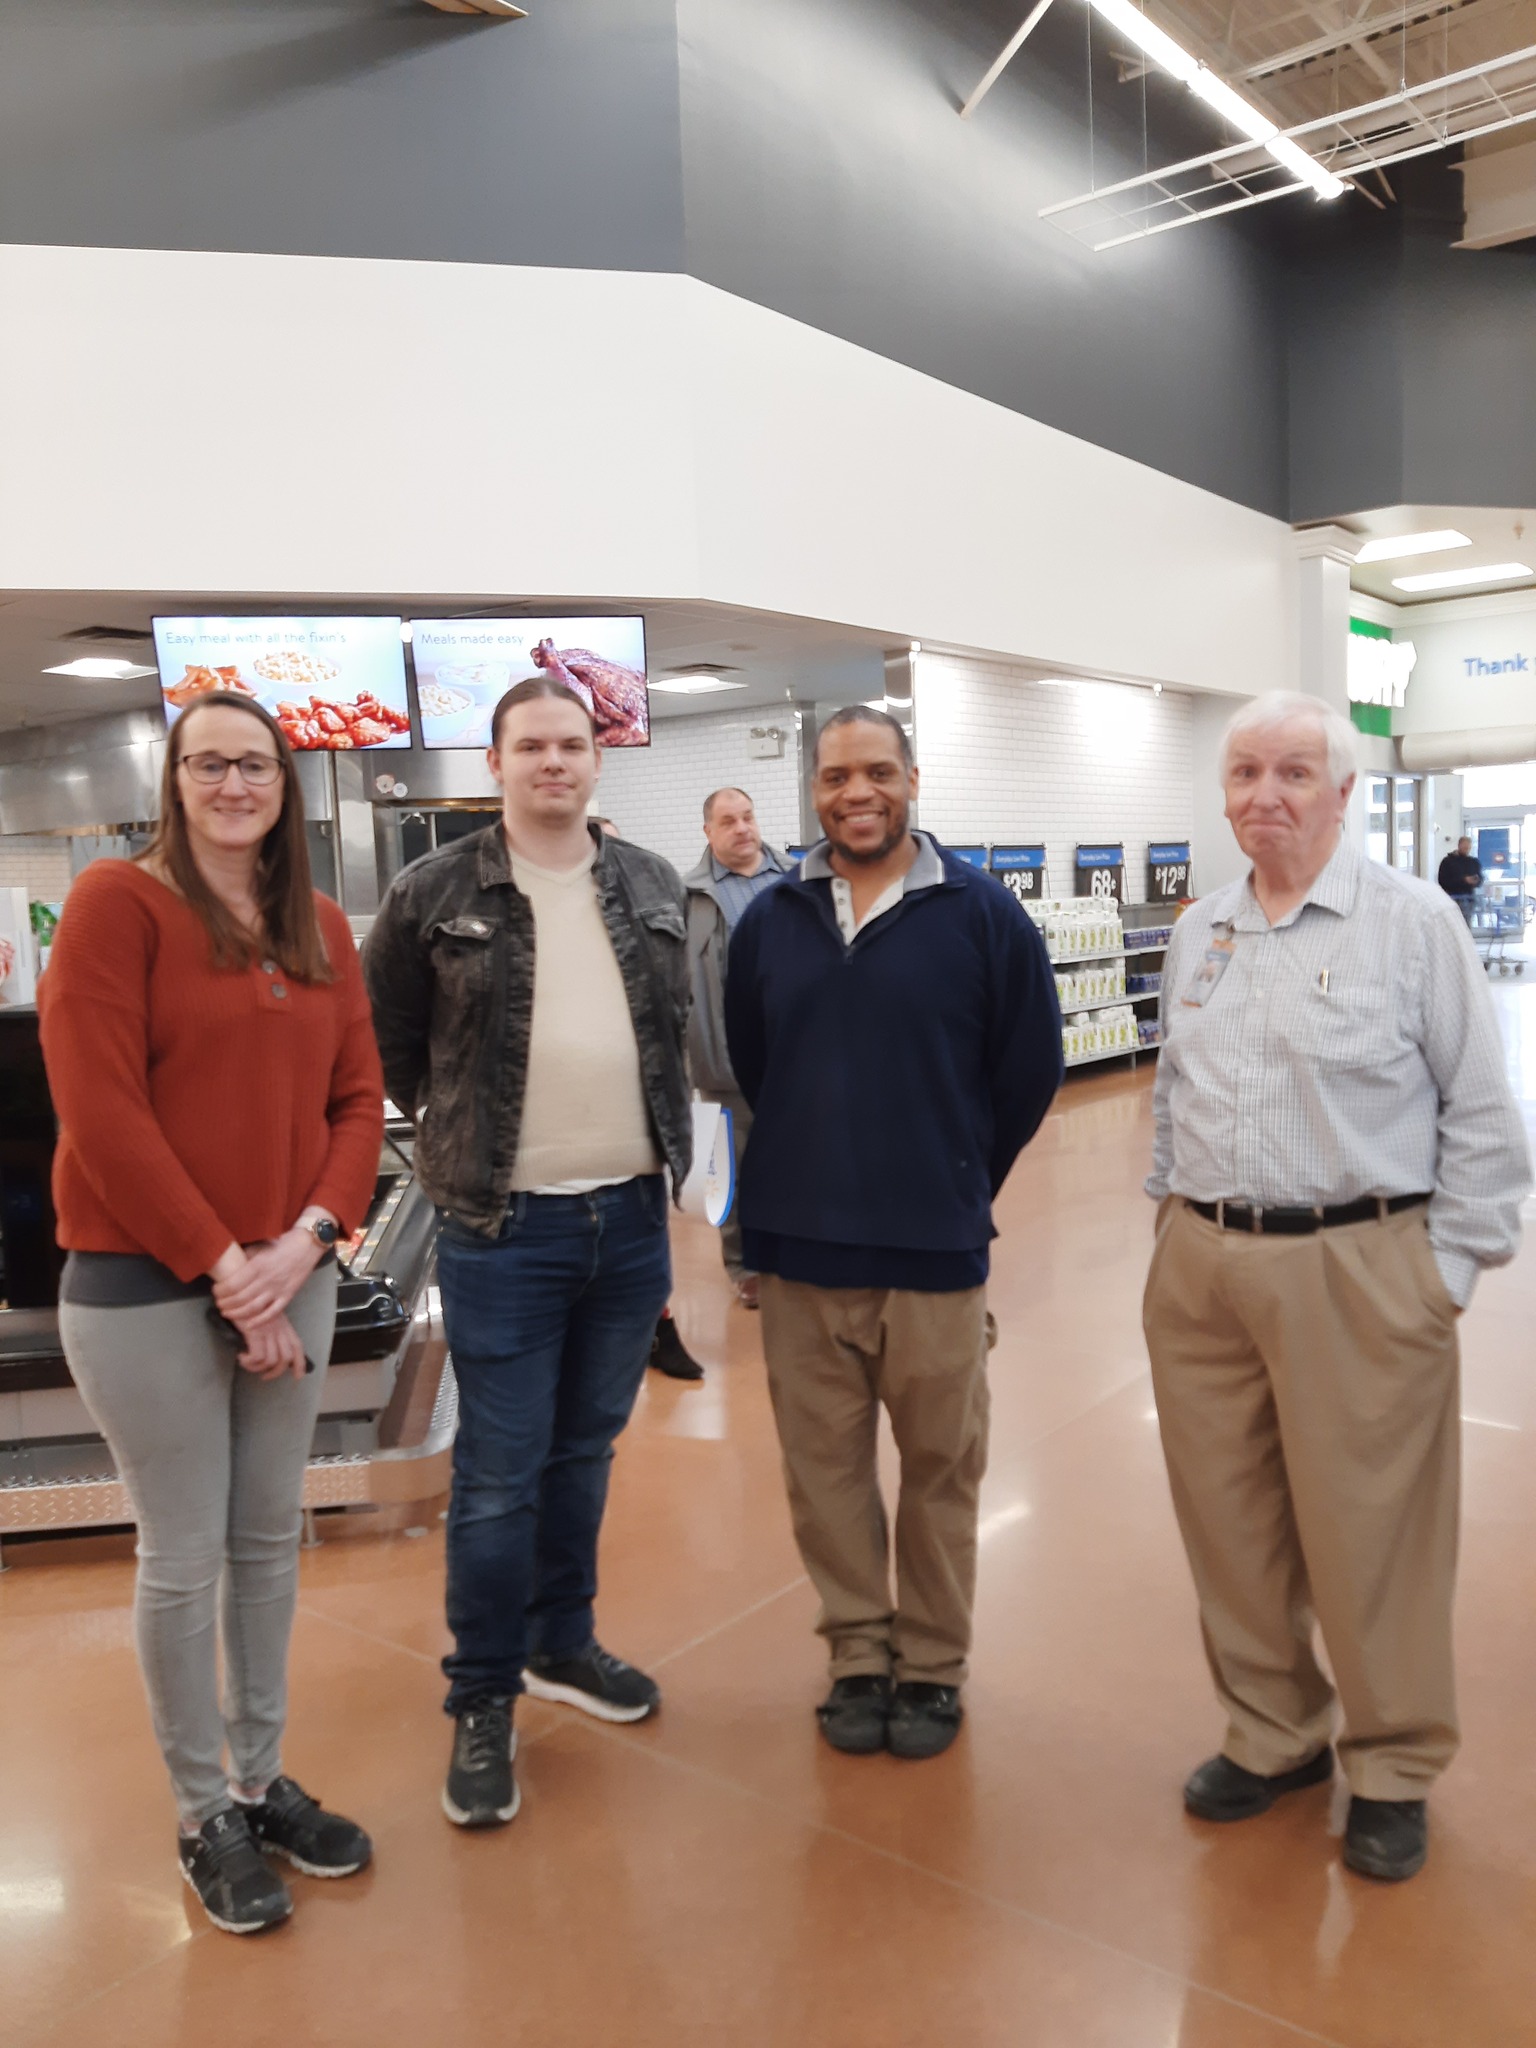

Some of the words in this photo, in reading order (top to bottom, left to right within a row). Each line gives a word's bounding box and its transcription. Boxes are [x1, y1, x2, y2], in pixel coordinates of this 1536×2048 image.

[166, 632, 195, 645] Easy
[200, 631, 230, 643] meal
[235, 631, 263, 643] with
[267, 632, 281, 643] all
[285, 632, 306, 643] the
[309, 631, 347, 644] fixin's
[421, 634, 457, 645] Meals
[460, 634, 494, 645] made
[497, 635, 524, 646] easy
[1464, 653, 1529, 677] Thank
